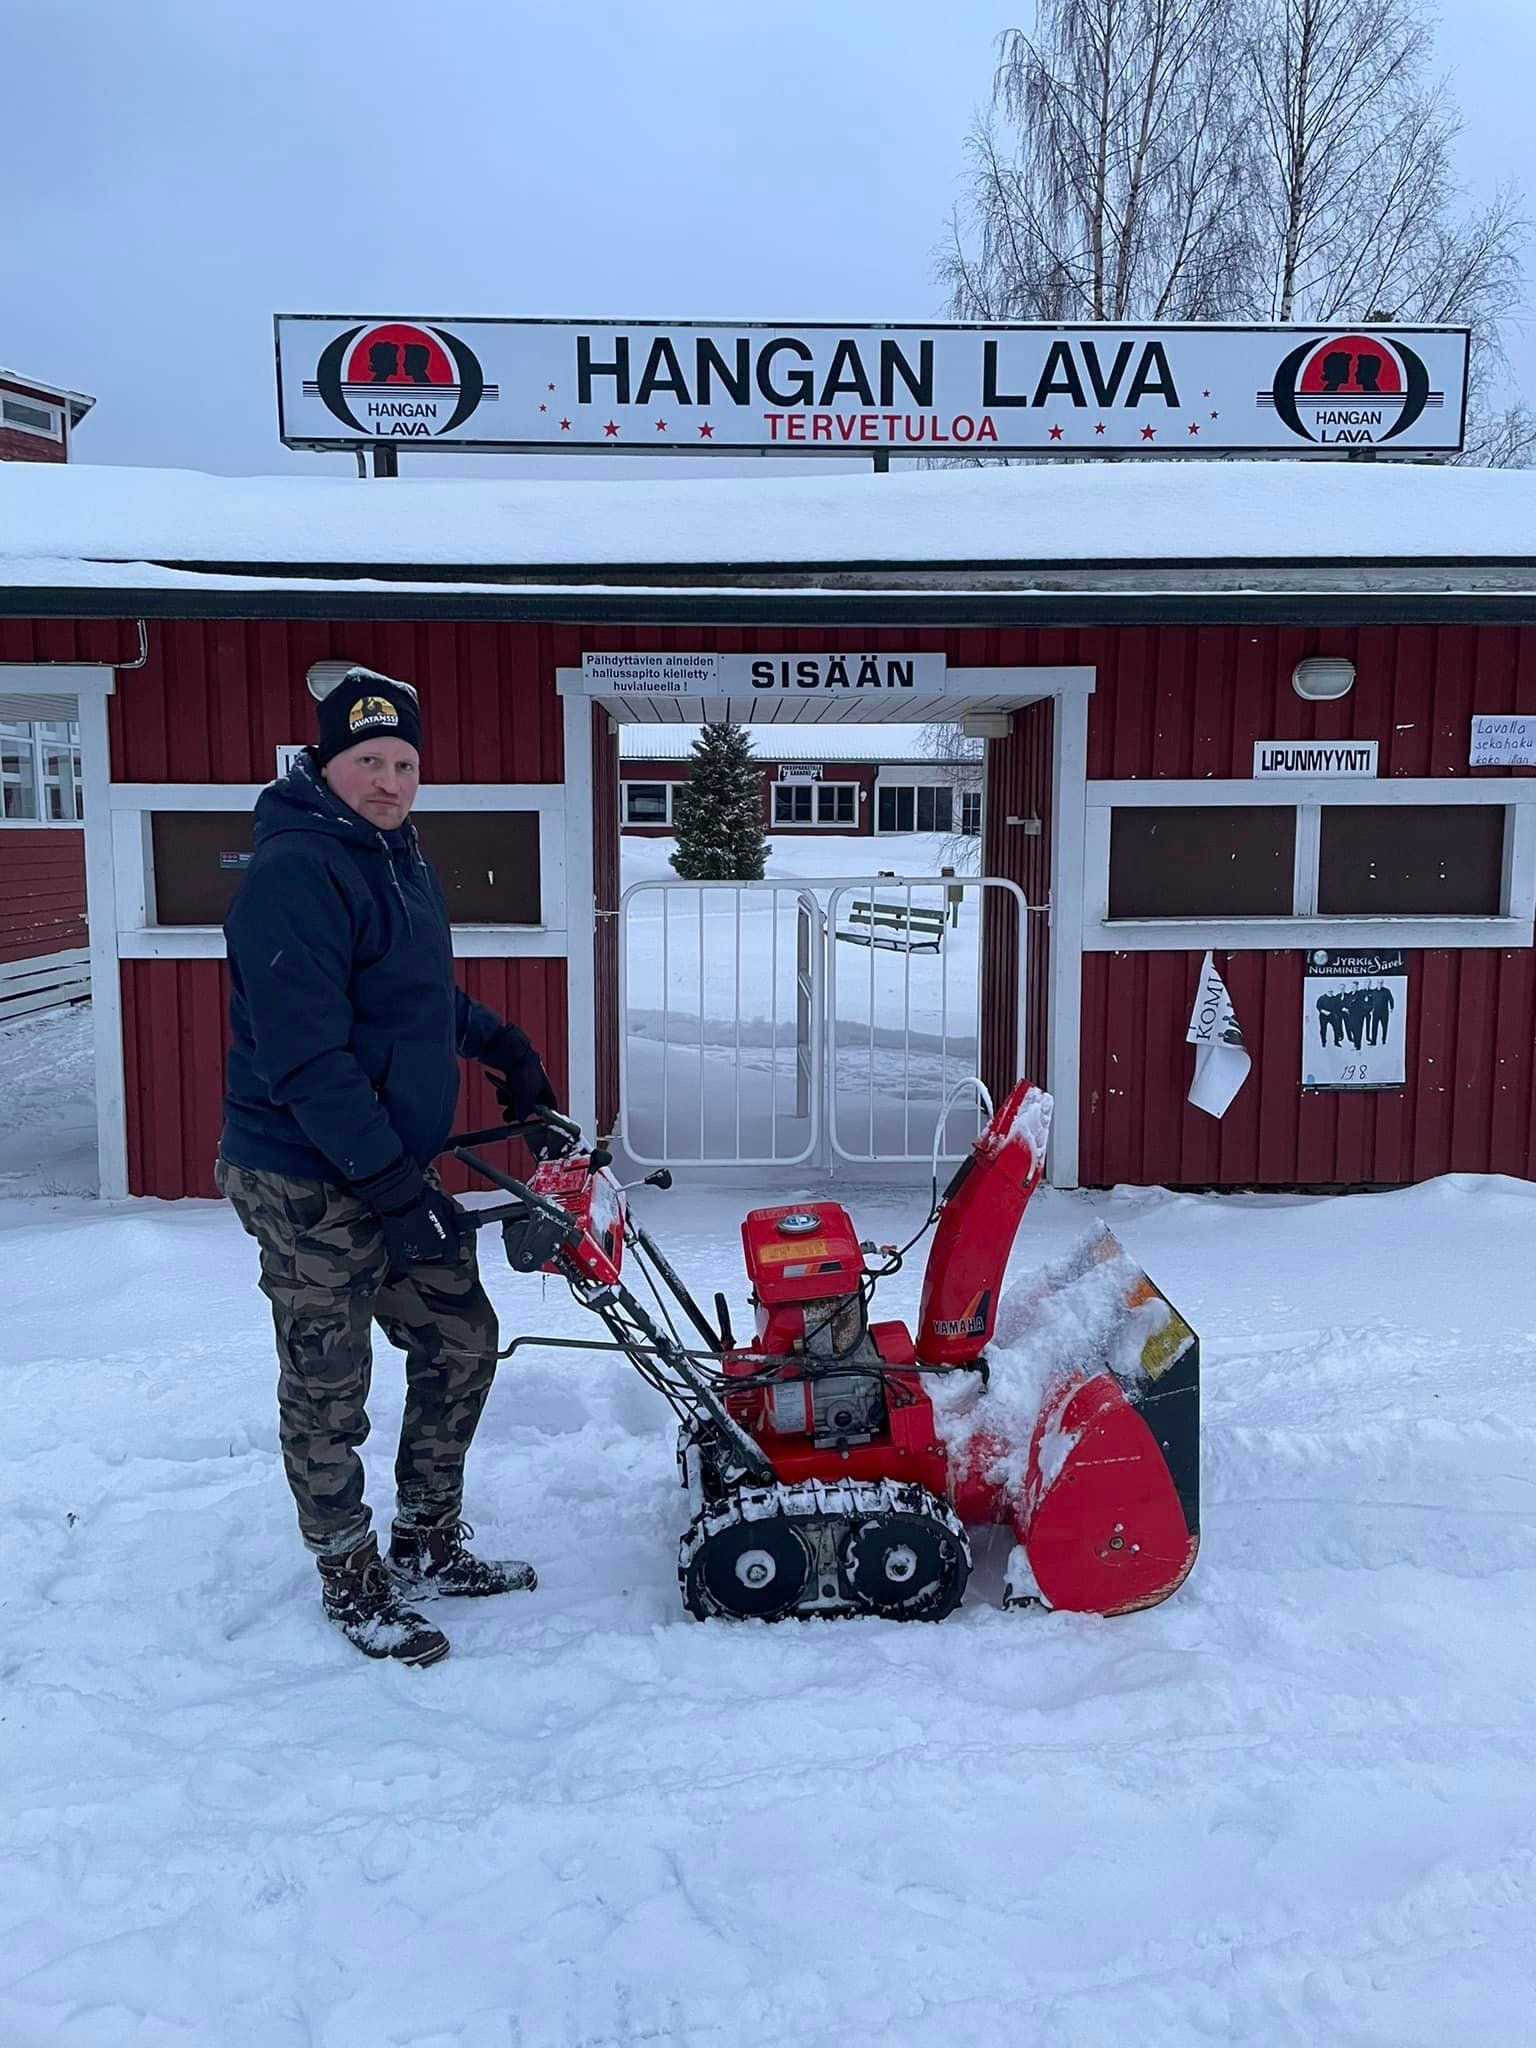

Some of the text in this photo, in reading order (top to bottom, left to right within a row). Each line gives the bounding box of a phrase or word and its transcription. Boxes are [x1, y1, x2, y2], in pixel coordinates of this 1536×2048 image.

[577, 336, 1181, 408] HANGAN LAVA
[367, 402, 437, 419] HANGAN
[1316, 411, 1382, 425] HANGAN
[375, 422, 431, 437] LAVA
[764, 413, 999, 442] TERVETULOA
[1320, 430, 1374, 443] LAVA
[586, 655, 714, 667] Päihdyttävien aineiden
[592, 668, 708, 681] hallussapito kielletty
[751, 655, 914, 689] SISÄÄN
[613, 682, 681, 691] huvialueella
[1477, 719, 1526, 734] Lavalla
[1474, 737, 1533, 749] sekahaku
[1261, 750, 1370, 771] LIPUNMYYNTI
[1333, 957, 1367, 966] JYRKI
[1309, 966, 1367, 974] NURMINEN
[932, 1316, 985, 1336] YAMAHA
